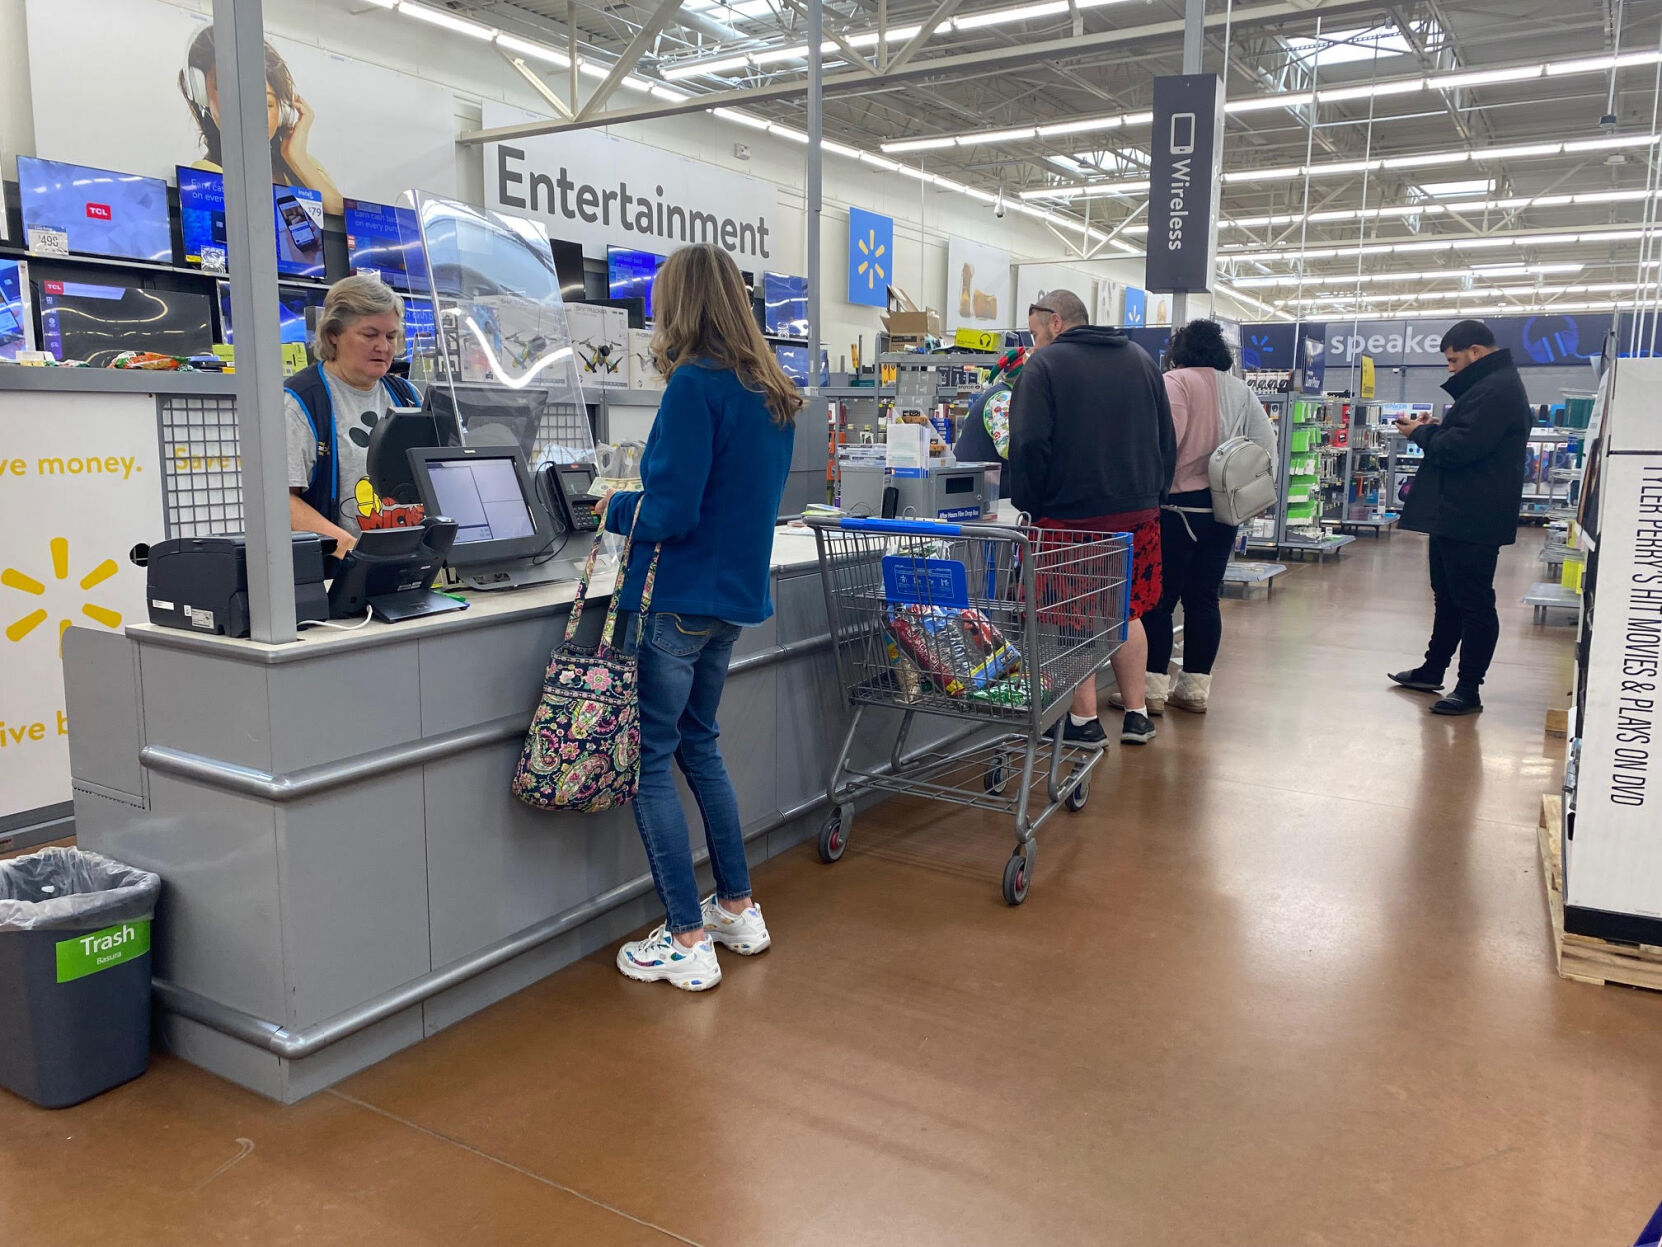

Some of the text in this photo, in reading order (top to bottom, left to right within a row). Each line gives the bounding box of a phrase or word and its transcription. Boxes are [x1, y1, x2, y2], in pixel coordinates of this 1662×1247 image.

[192, 191, 225, 203] on ever
[498, 144, 770, 259] Entertainment
[1168, 158, 1192, 251] Wireless
[89, 206, 108, 217] TCL
[1330, 326, 1441, 362] speake
[0, 456, 143, 480] ve money.
[174, 446, 230, 470] Save
[1631, 519, 1662, 584] PERRY'S
[1628, 588, 1662, 614] HIT
[1622, 617, 1662, 677] MOVIES
[1621, 680, 1656, 694] &
[1615, 696, 1655, 743] PLAYS
[0, 721, 46, 748] ive
[1613, 747, 1650, 771] ON
[1609, 773, 1646, 807] DVD
[80, 924, 135, 956] Trash
[96, 951, 122, 965] Basura
